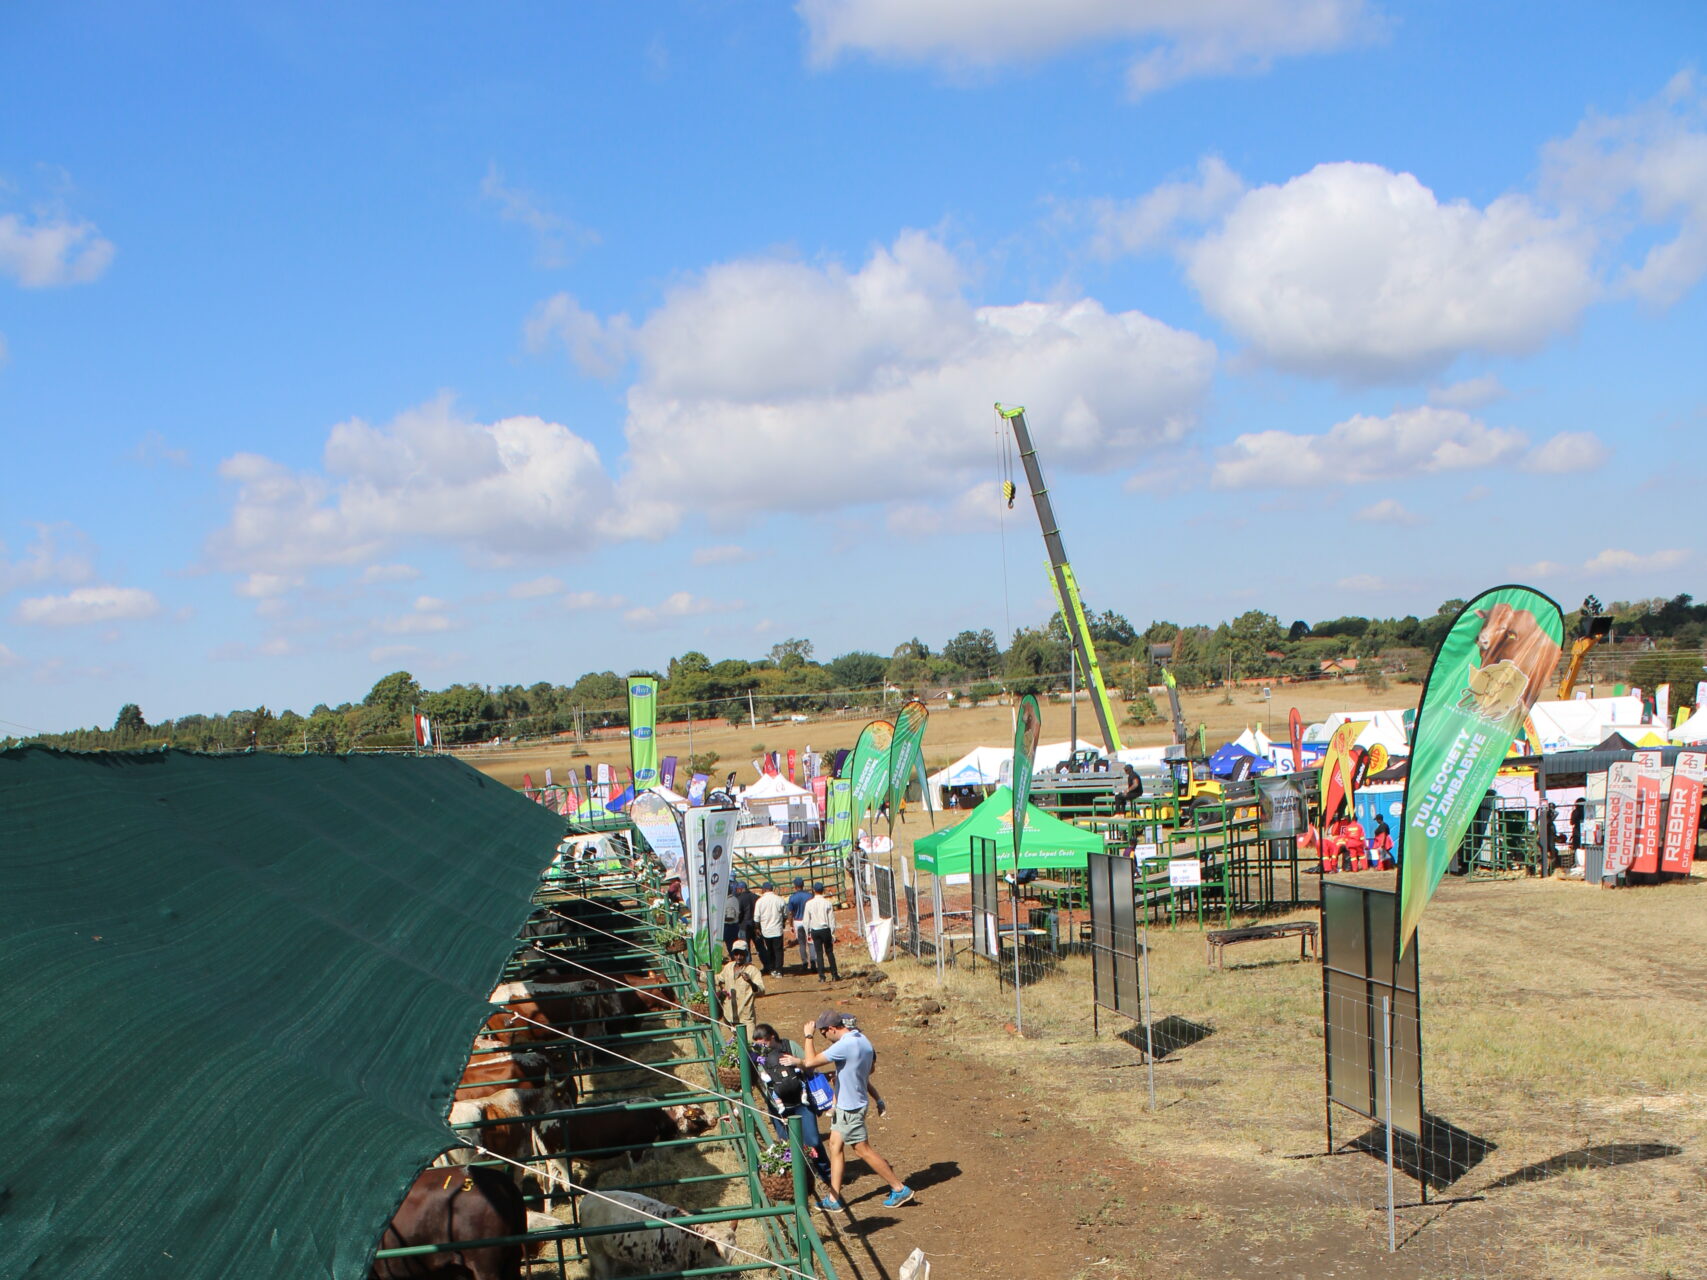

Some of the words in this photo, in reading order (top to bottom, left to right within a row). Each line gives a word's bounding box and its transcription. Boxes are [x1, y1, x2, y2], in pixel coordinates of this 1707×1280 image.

[1412, 794, 1438, 828] TULI
[1431, 728, 1470, 795] SOCIETY
[1425, 817, 1442, 838] OF
[1437, 733, 1487, 817] ZIMBABWE
[1648, 791, 1658, 826] SALE
[1605, 797, 1620, 870] Prepacked
[1620, 801, 1634, 866] Concrete
[1646, 828, 1656, 855] FOR
[1665, 788, 1688, 861] REBAR
